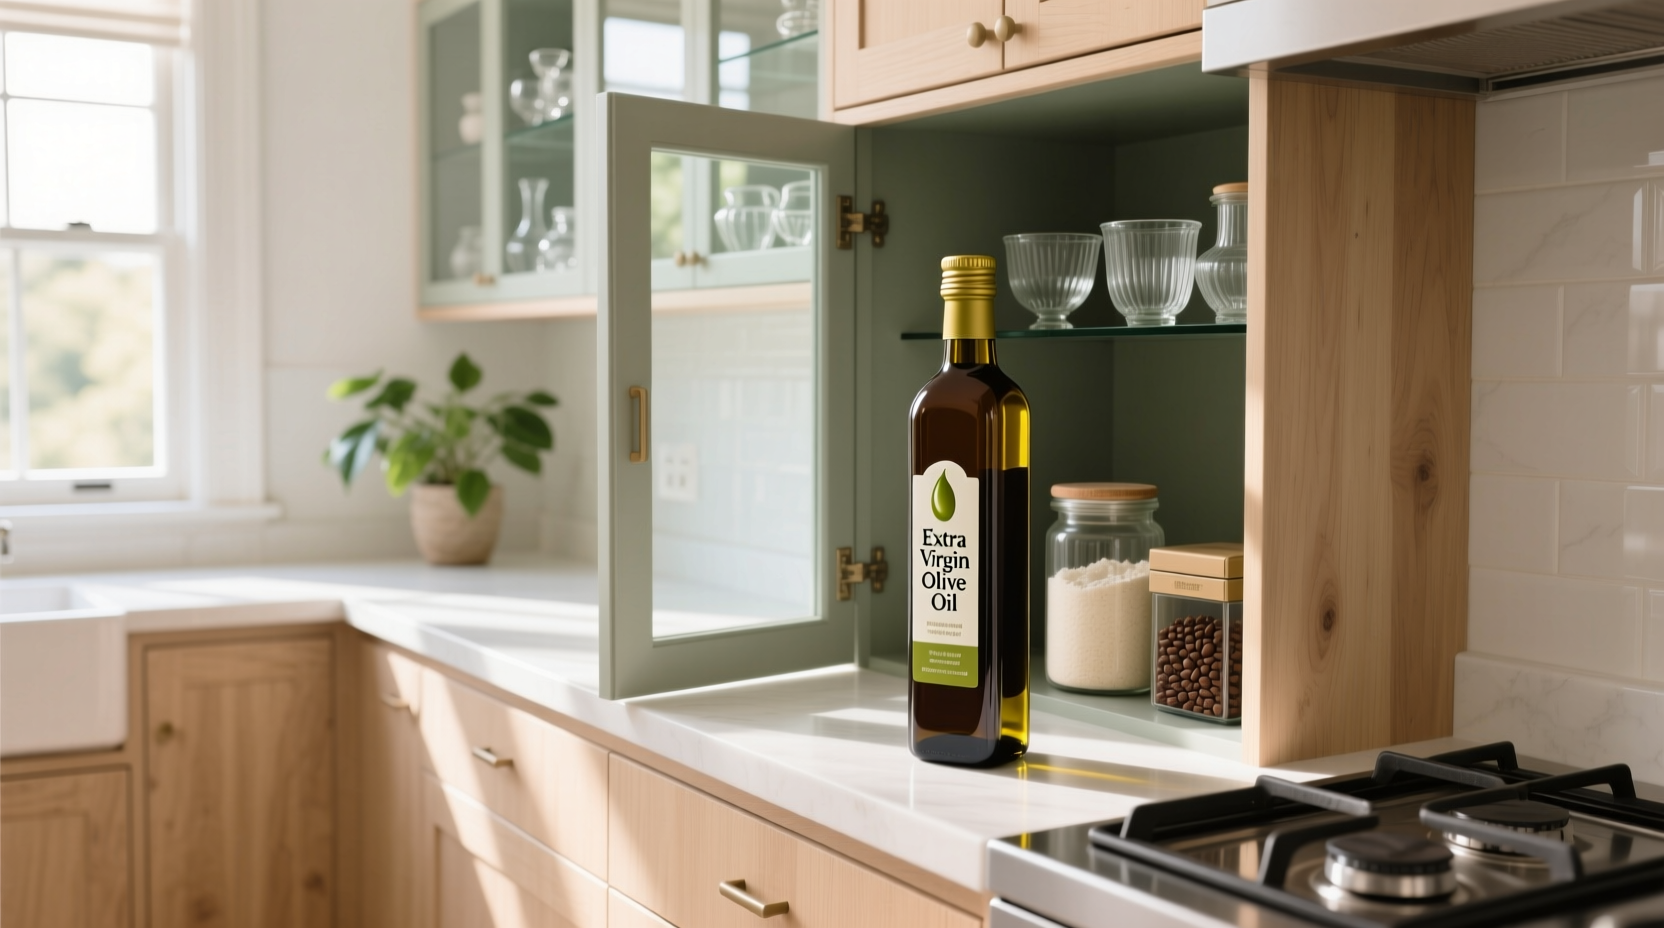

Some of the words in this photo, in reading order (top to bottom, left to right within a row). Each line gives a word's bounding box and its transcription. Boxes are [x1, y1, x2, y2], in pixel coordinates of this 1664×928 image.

[922, 528, 967, 548] Extra
[919, 548, 970, 573] Virgin
[921, 571, 967, 591] Olive
[931, 592, 958, 611] Oil
